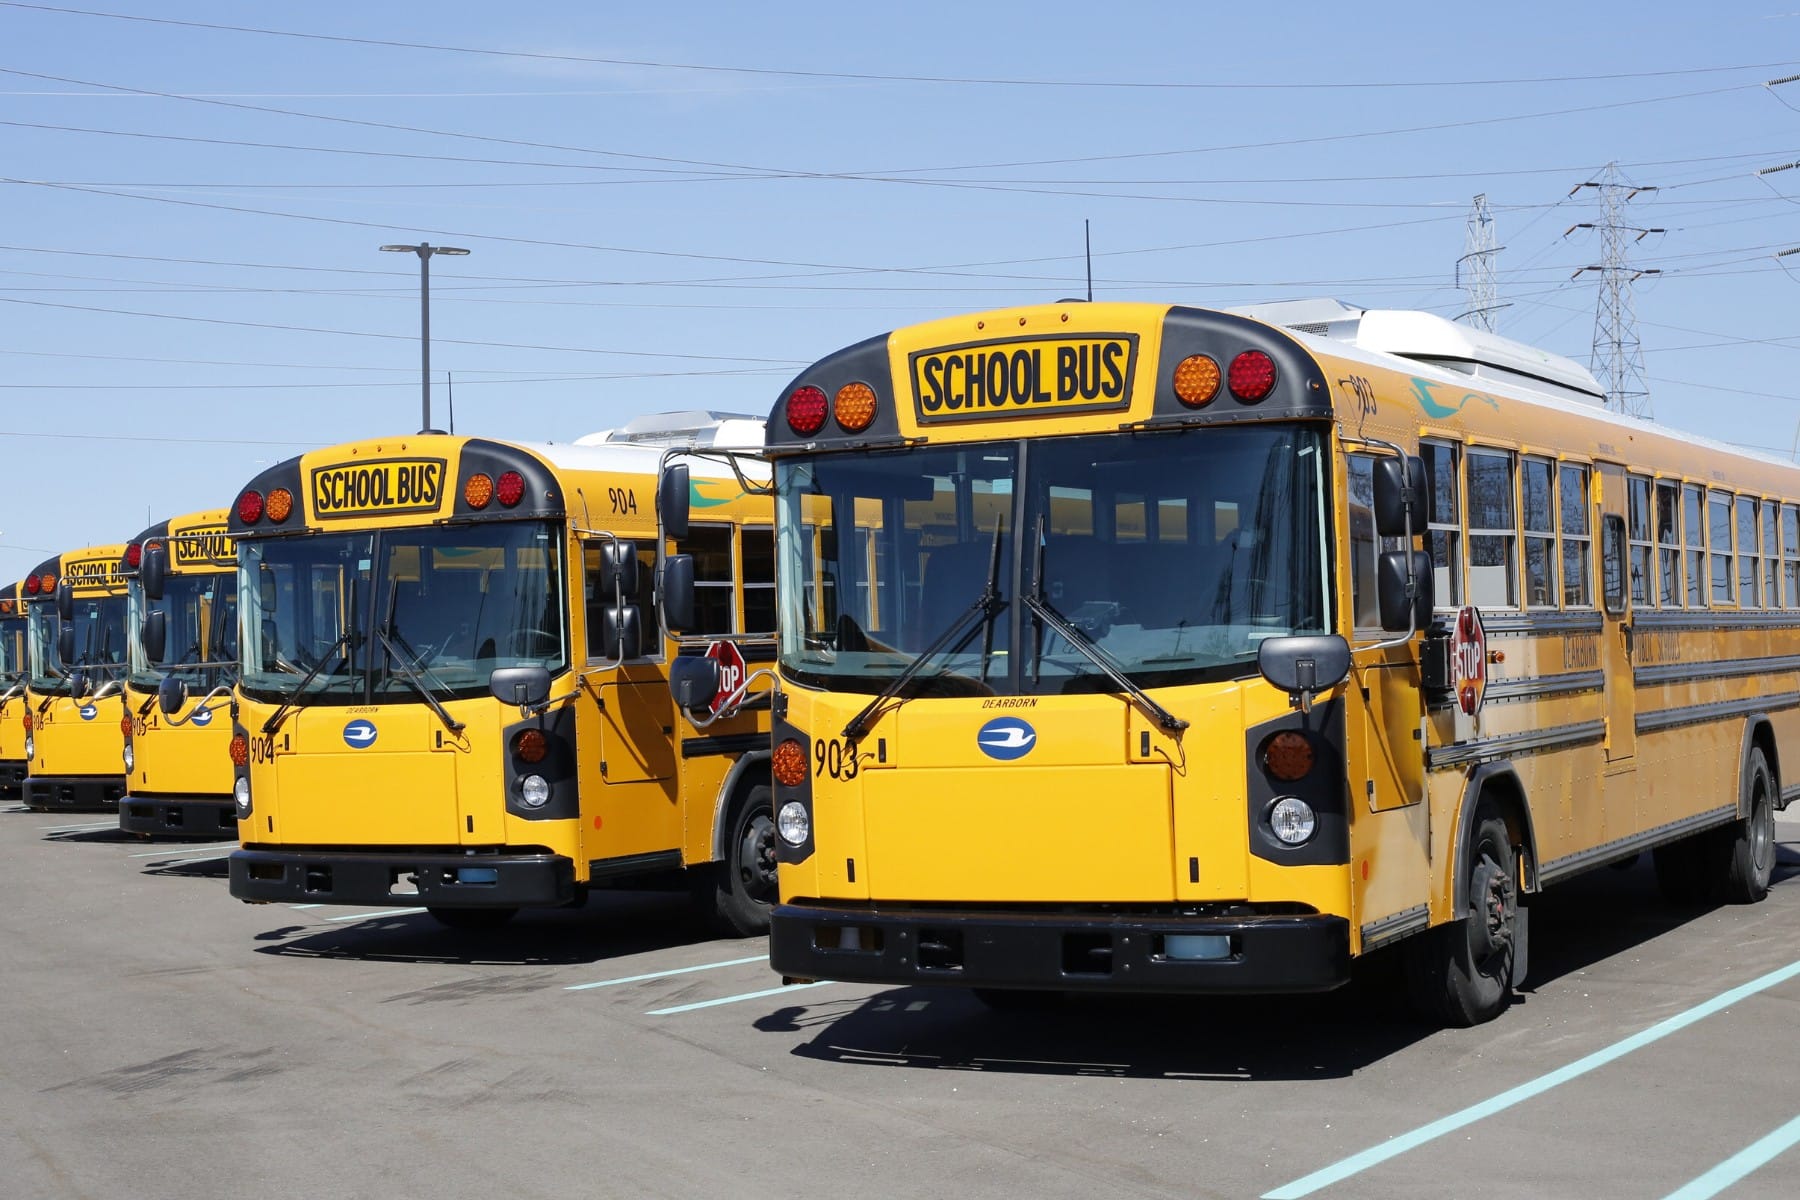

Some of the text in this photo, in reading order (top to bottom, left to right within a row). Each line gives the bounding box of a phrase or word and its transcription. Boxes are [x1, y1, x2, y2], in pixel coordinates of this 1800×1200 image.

[923, 342, 1123, 411] SCHOOL BUS
[1349, 374, 1377, 416] 903
[319, 464, 437, 510] SCHOOL BUS
[608, 487, 637, 515] 904
[179, 530, 228, 558] SCHOOL
[70, 562, 129, 586] SCHOOL BU
[1457, 641, 1480, 680] STOP
[982, 698, 1039, 709] DEARBORN
[132, 716, 147, 736] 905
[251, 736, 275, 765] 904
[815, 738, 859, 780] 903
